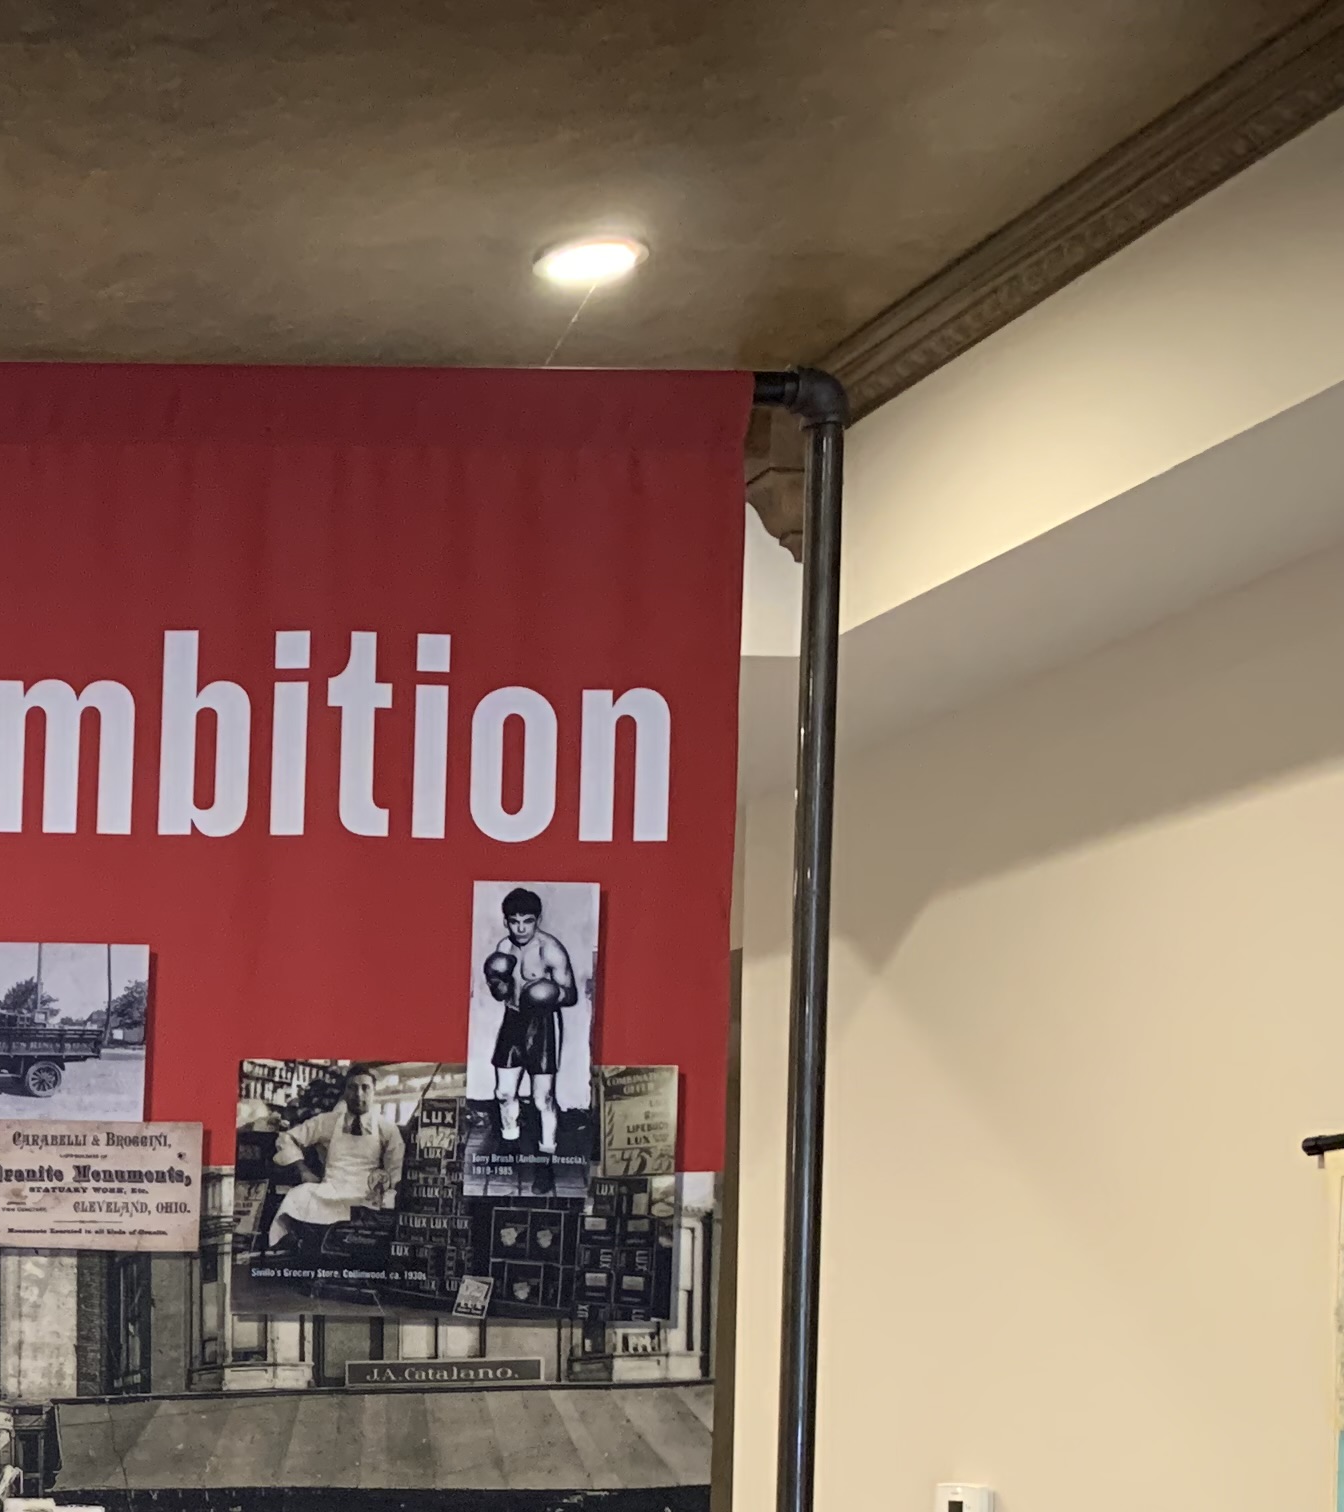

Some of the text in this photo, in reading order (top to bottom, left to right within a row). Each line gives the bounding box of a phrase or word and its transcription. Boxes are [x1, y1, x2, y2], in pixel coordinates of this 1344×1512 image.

[423, 1111, 454, 1124] LUX
[13, 1132, 172, 1151] CARABELLI & BROGGINI,
[627, 1136, 650, 1146] LUX
[424, 1148, 442, 1159] LUX
[472, 1154, 550, 1165] Tony Brush (Anthony
[73, 1165, 192, 1187] Monuments,
[29, 1186, 87, 1194] STATUARY
[596, 1184, 614, 1195] LUX
[73, 1202, 192, 1218] CLEVELAND, OHIO.
[410, 1217, 427, 1228] LUX
[431, 1217, 448, 1229] LUX
[391, 1245, 410, 1256] LUX
[284, 1268, 427, 1281] Grocery ca. 1930s
